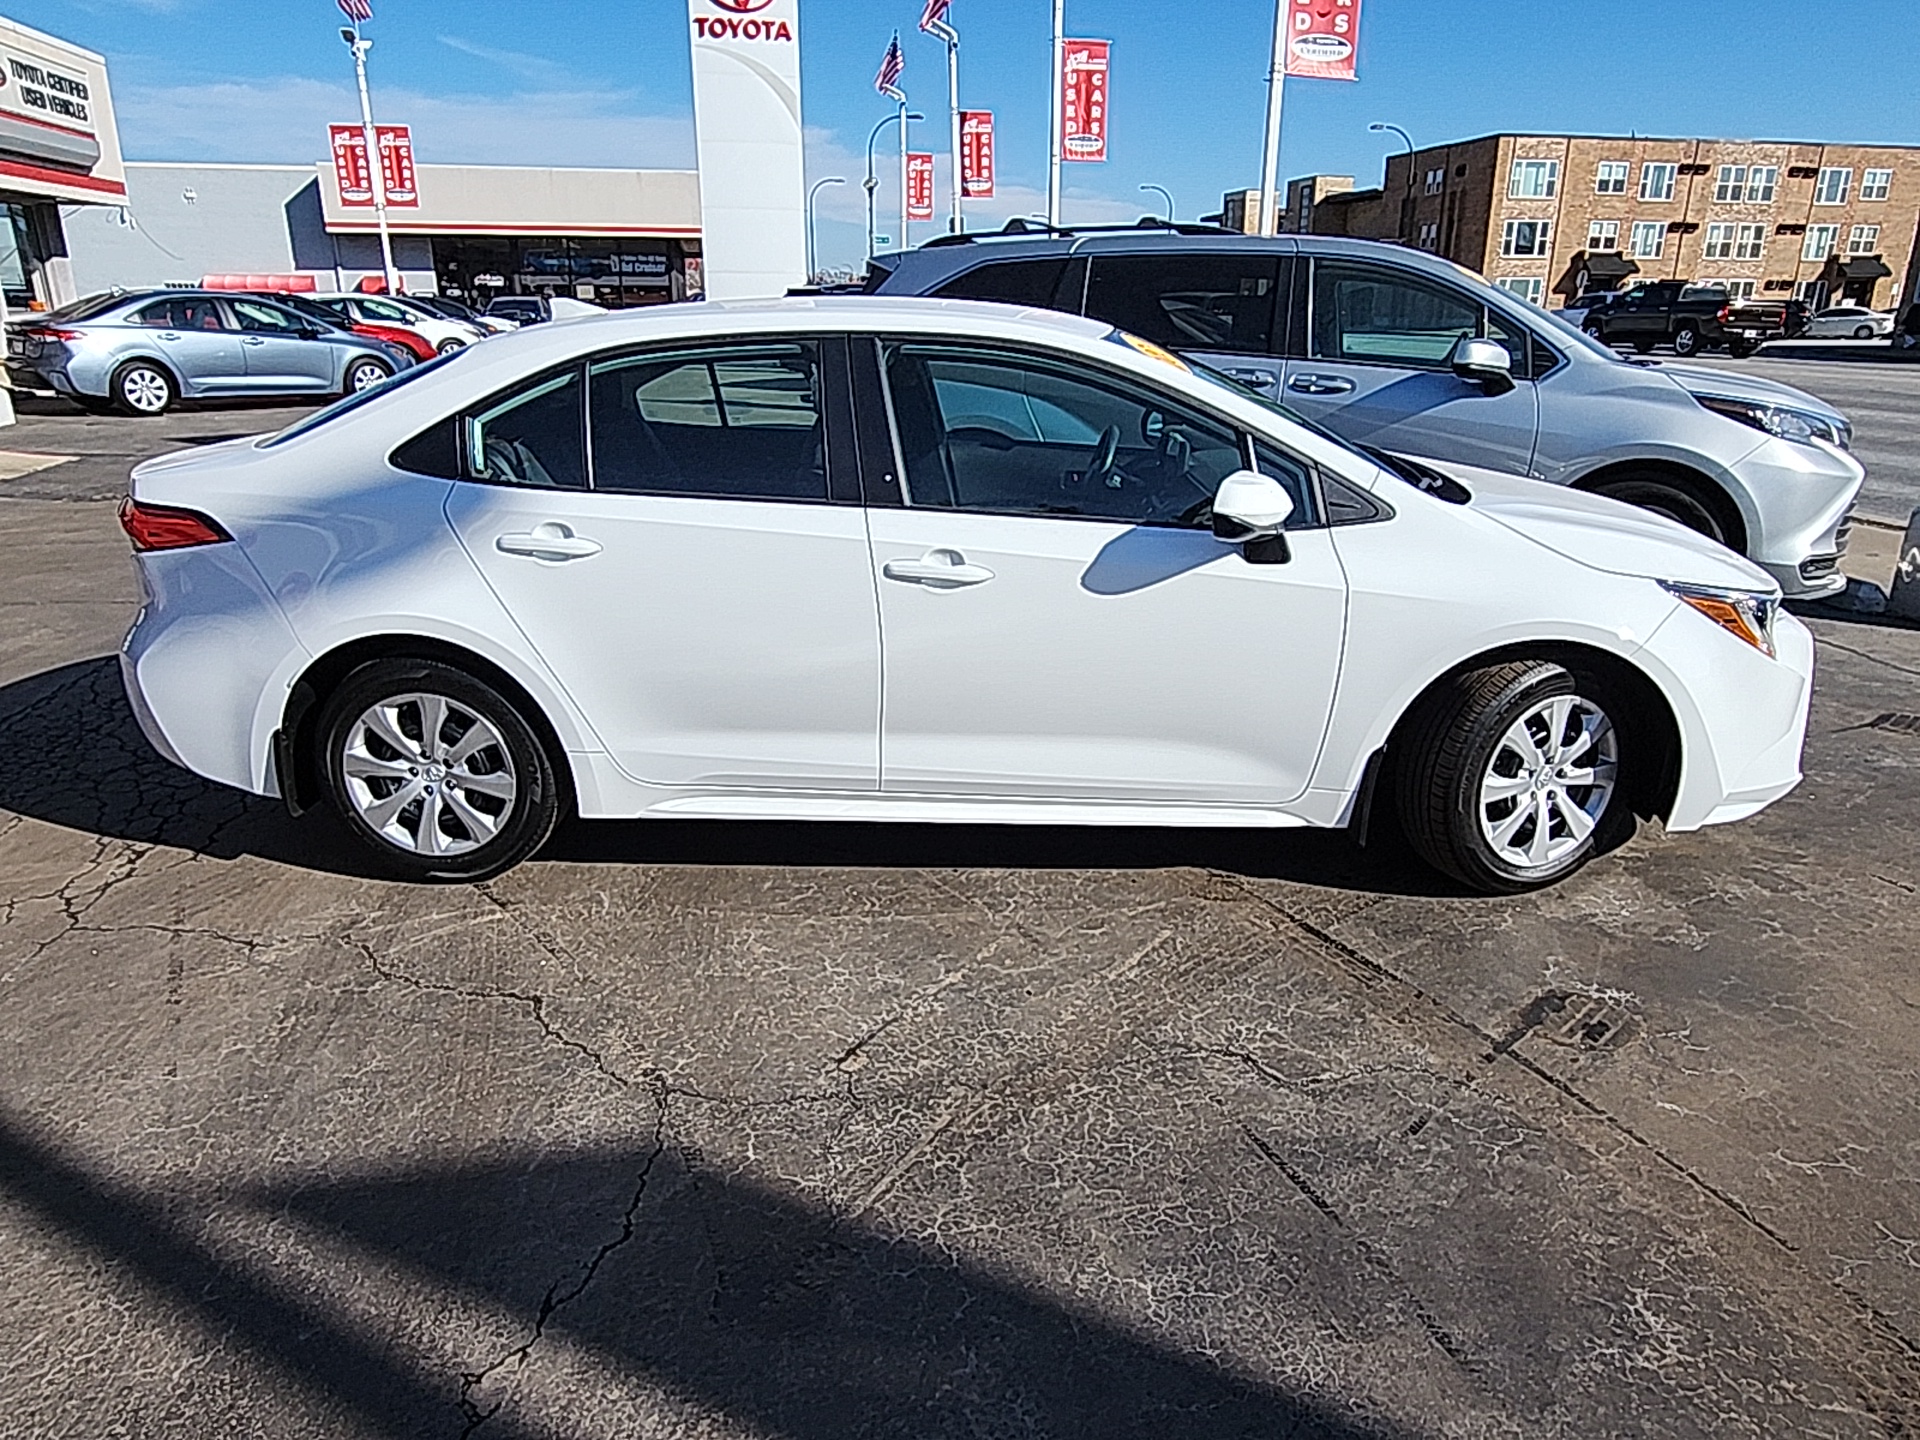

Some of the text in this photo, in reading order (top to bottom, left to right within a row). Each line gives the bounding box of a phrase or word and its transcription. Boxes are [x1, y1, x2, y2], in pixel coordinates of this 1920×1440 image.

[692, 17, 792, 42] TOYOTA
[7, 57, 47, 88] TOYOTA
[19, 84, 47, 110] USED
[1065, 72, 1104, 135] USED CARS
